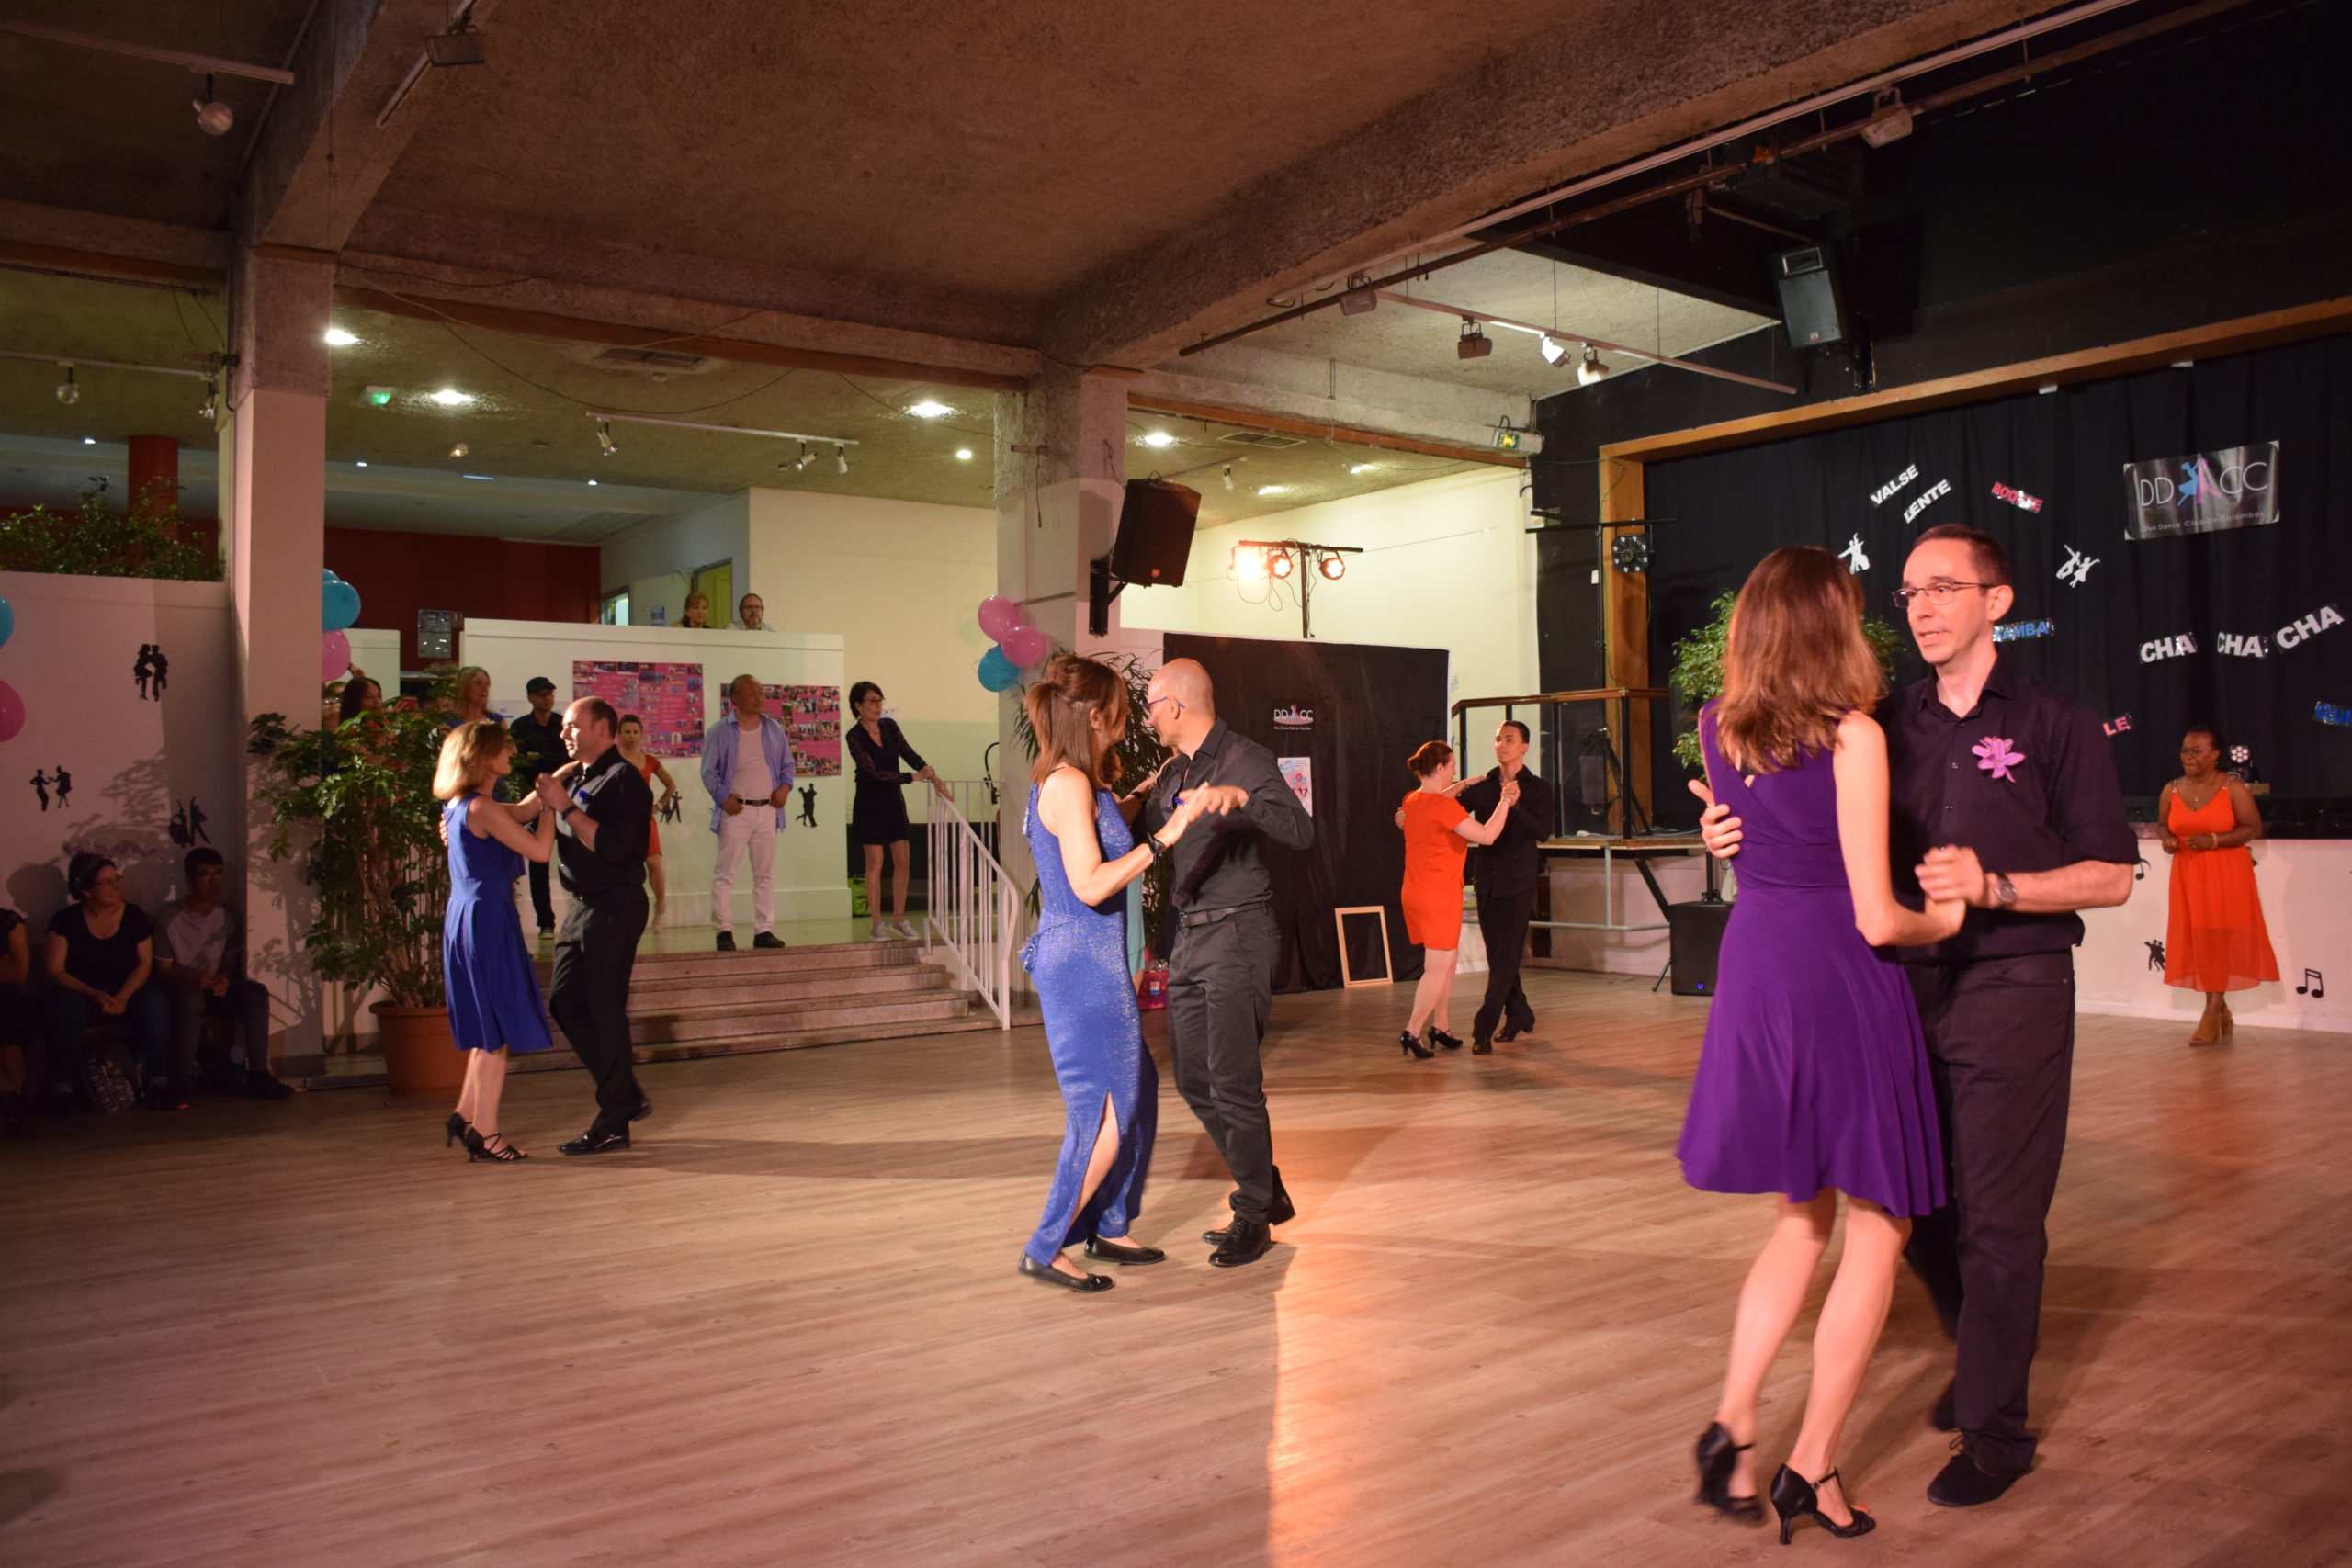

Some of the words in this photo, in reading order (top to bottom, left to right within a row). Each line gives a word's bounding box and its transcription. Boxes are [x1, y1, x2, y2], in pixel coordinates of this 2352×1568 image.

[1870, 463, 1919, 505] VALSE
[1903, 479, 1952, 525] LENTE
[1991, 481, 2043, 513] BOOE
[2140, 633, 2197, 662] CHA
[2217, 632, 2264, 658] CHA
[2276, 605, 2345, 649] CHA
